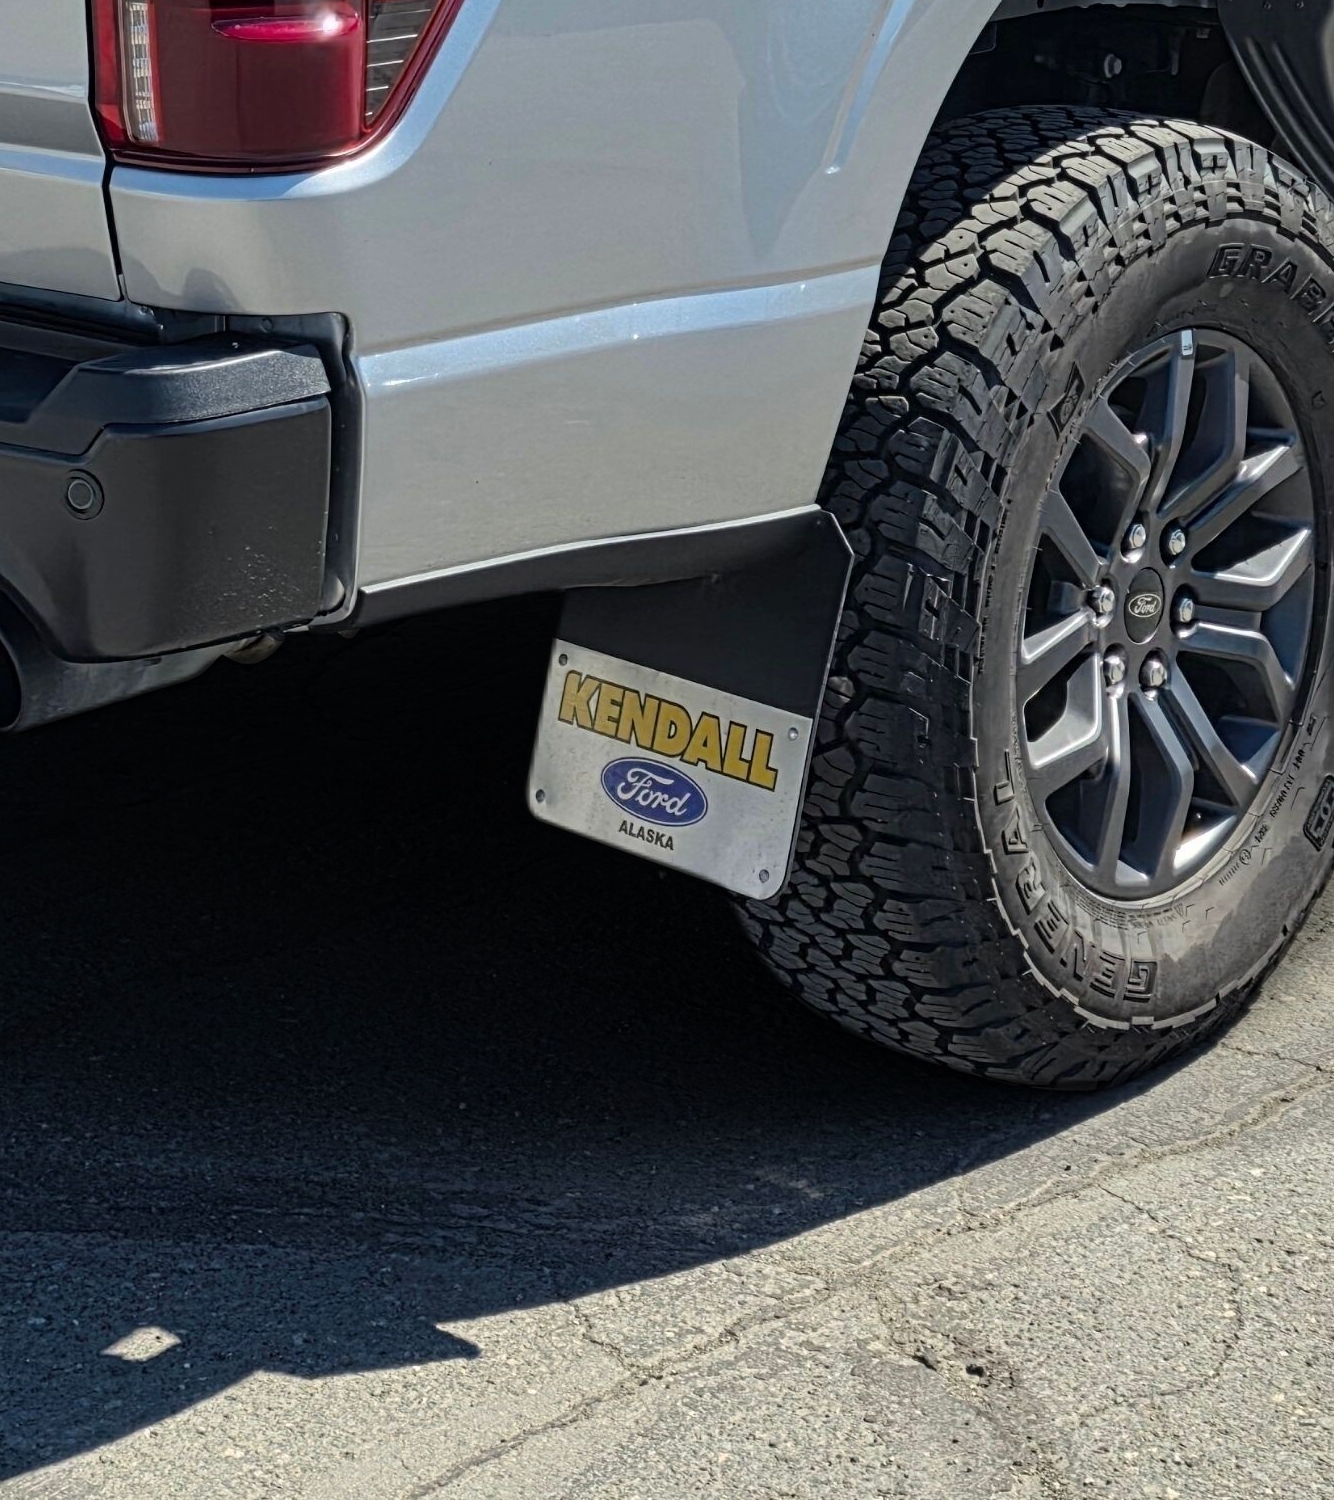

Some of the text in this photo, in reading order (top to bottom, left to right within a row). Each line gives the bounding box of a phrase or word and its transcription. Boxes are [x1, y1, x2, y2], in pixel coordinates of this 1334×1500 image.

[1133, 596, 1158, 614] Ford
[557, 669, 779, 793] KENDALL
[616, 766, 693, 817] Ford
[617, 819, 675, 852] ALASKA
[992, 748, 1159, 1004] GENERAL
